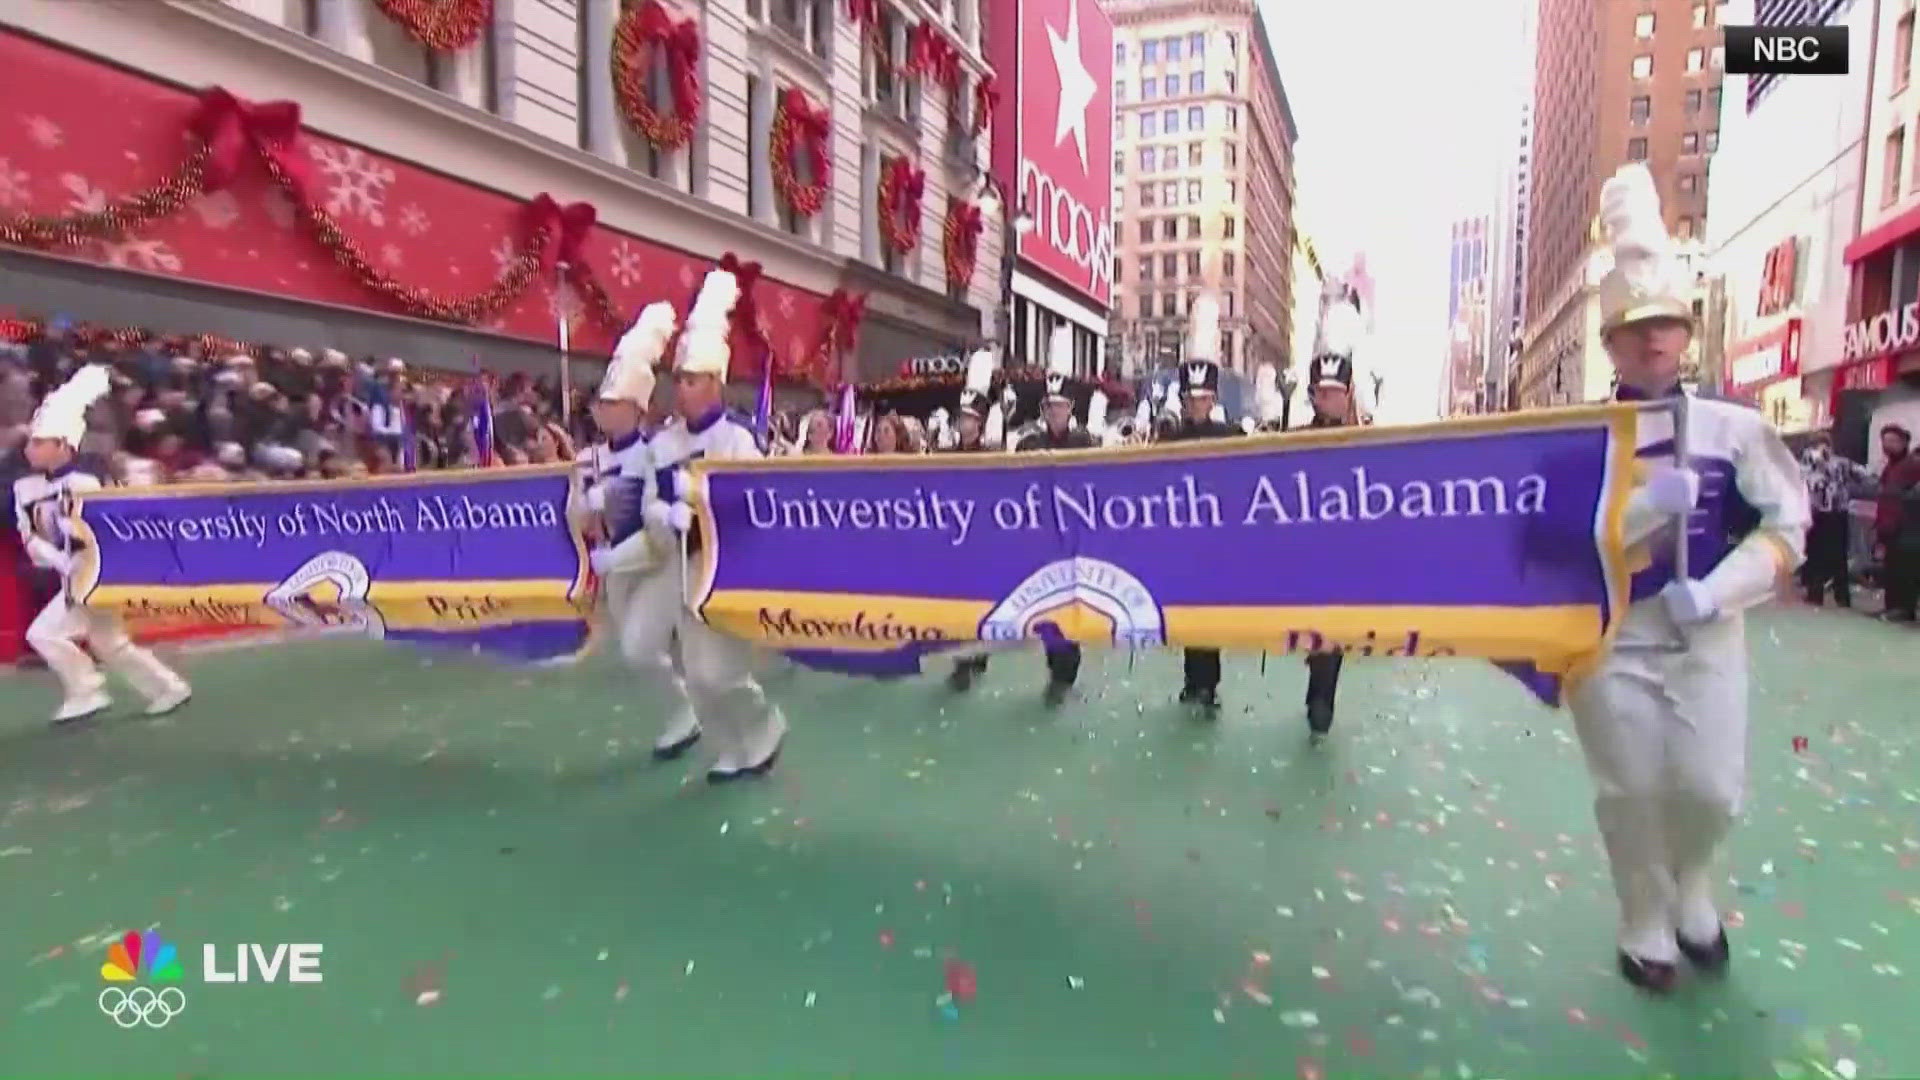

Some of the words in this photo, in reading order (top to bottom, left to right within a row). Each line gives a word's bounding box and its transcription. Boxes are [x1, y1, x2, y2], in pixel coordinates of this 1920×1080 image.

[1841, 301, 1920, 361] FAMOUS
[101, 504, 267, 549] University
[278, 502, 307, 537] of
[311, 496, 405, 537] North
[416, 494, 557, 532] Alabama
[744, 488, 976, 546] University
[993, 483, 1042, 531] of
[1052, 475, 1222, 533] North
[1242, 466, 1548, 526] Alabama
